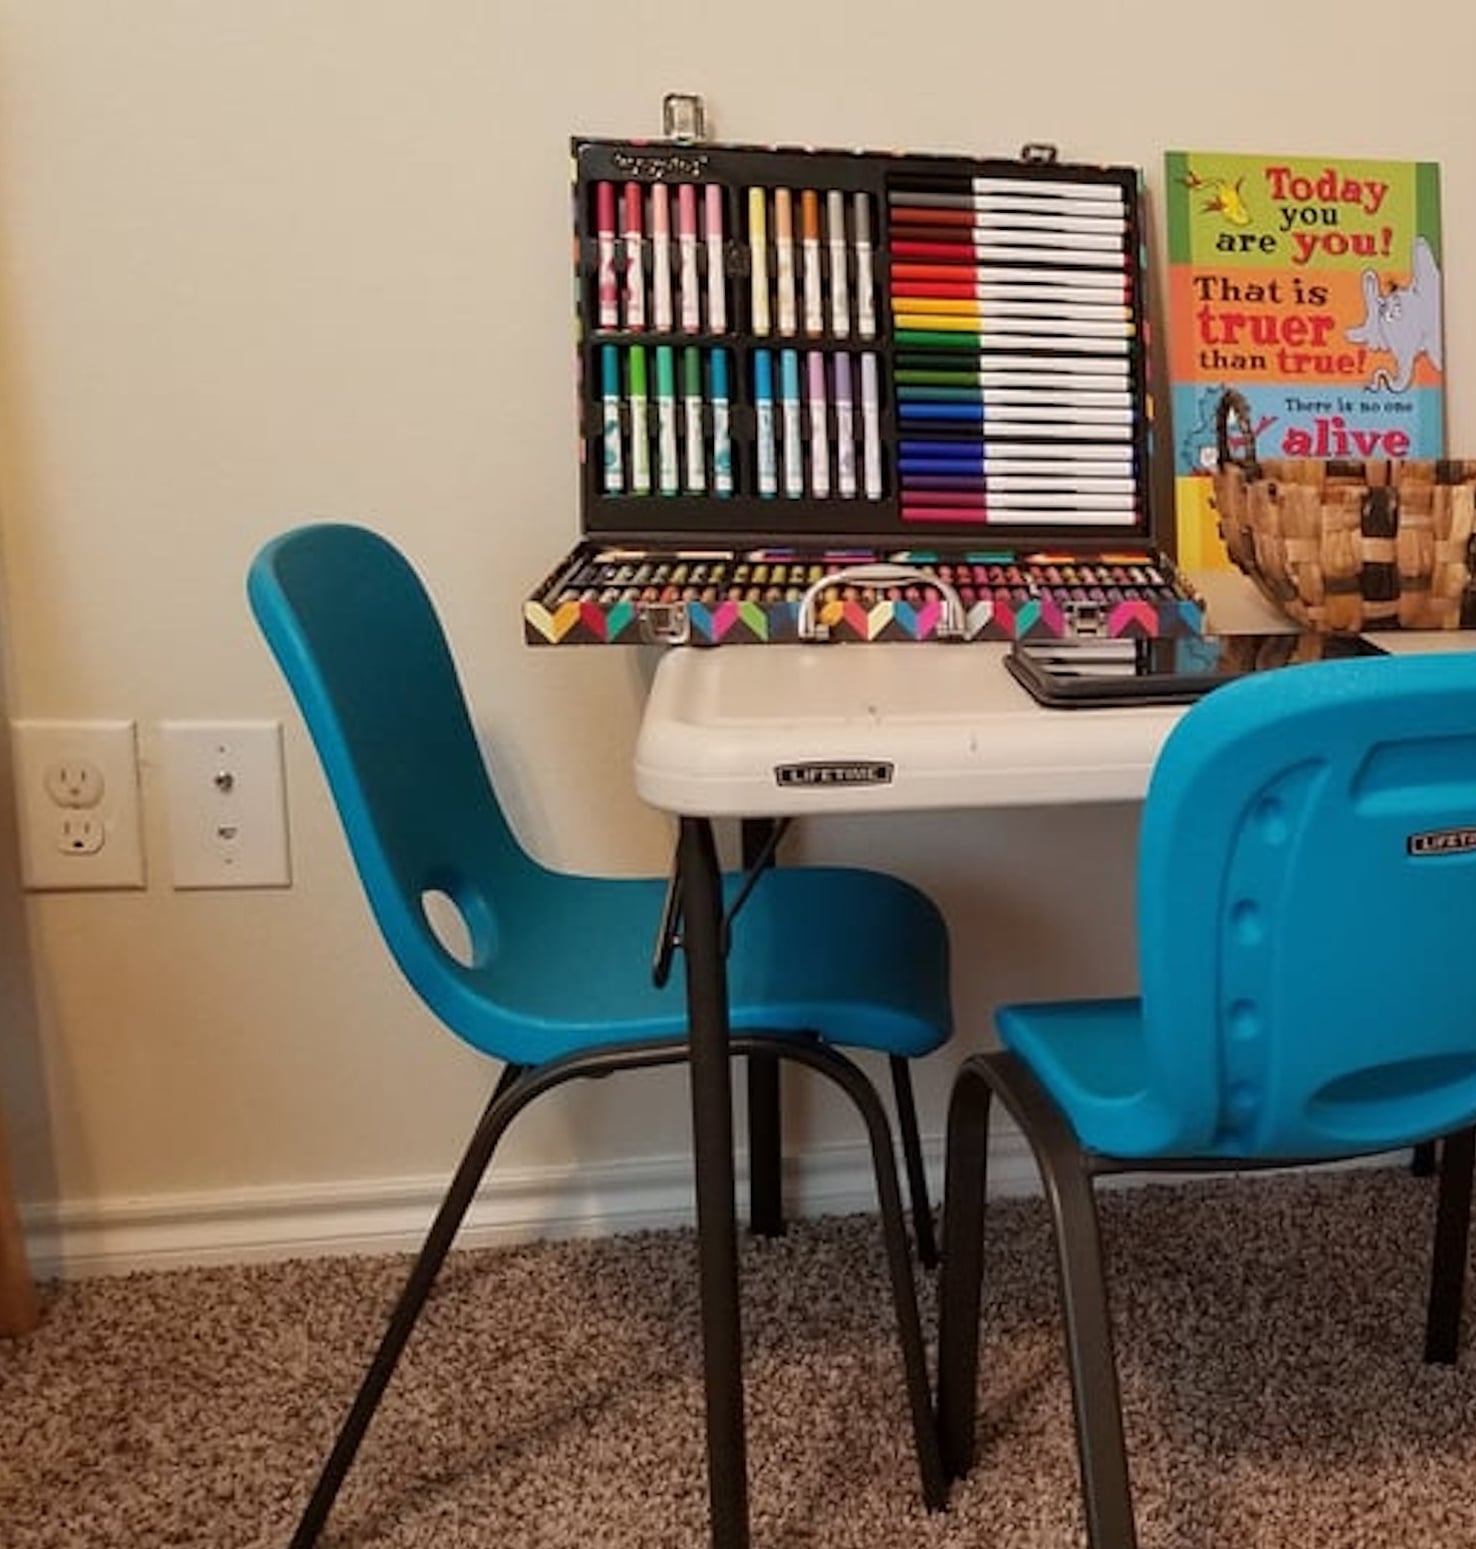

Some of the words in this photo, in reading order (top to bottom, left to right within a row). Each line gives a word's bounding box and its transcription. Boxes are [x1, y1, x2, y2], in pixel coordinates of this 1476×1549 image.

[1265, 167, 1388, 214] Today
[1280, 206, 1338, 231] you
[1217, 231, 1276, 253] are
[1291, 227, 1393, 264] you!
[1194, 276, 1281, 302] That
[1293, 278, 1328, 305] is
[1197, 304, 1335, 346] truer
[1200, 350, 1266, 370] than
[1277, 347, 1367, 374] true!
[1285, 399, 1331, 411] There
[1338, 399, 1352, 411] is
[1360, 401, 1380, 411] no
[1384, 402, 1413, 412] one
[1282, 416, 1410, 457] alive
